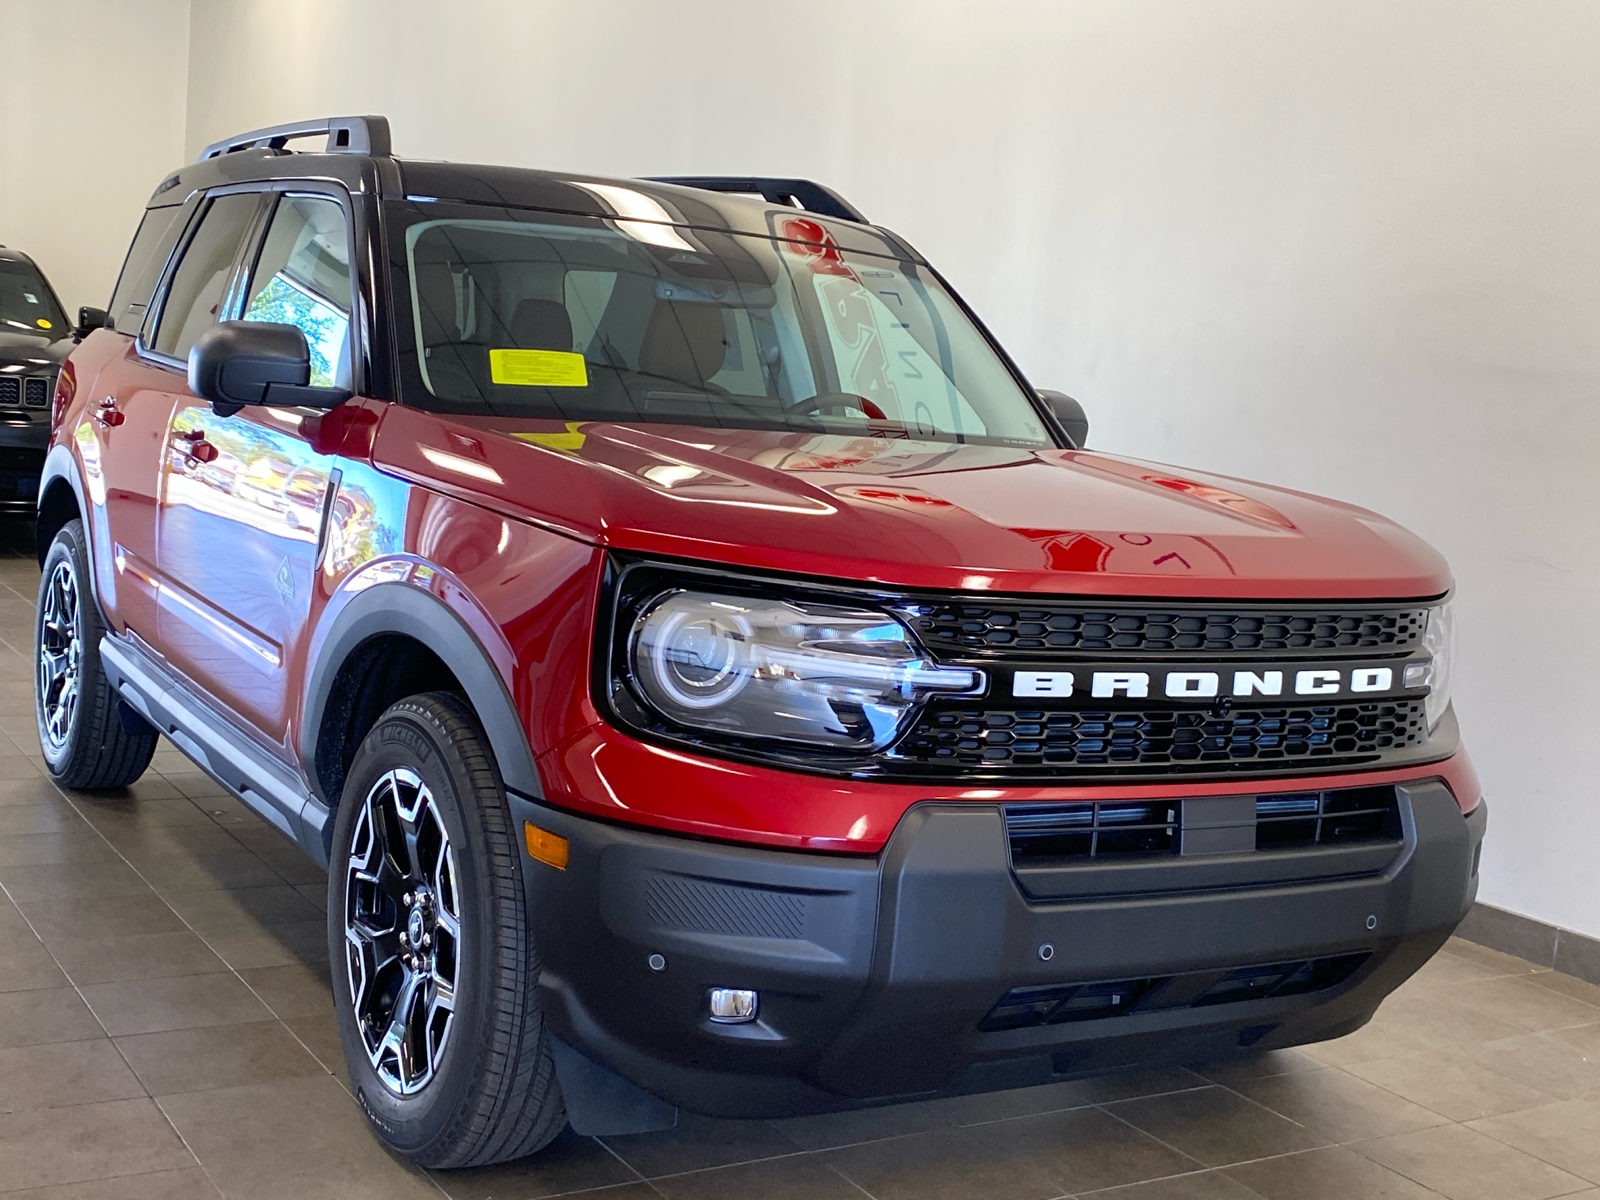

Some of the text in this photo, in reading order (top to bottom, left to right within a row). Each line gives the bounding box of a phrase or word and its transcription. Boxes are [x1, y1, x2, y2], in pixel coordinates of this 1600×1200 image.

[1012, 667, 1393, 698] BRONCO
[383, 726, 431, 758] MICHELIN
[432, 762, 458, 812] PRIMACY
